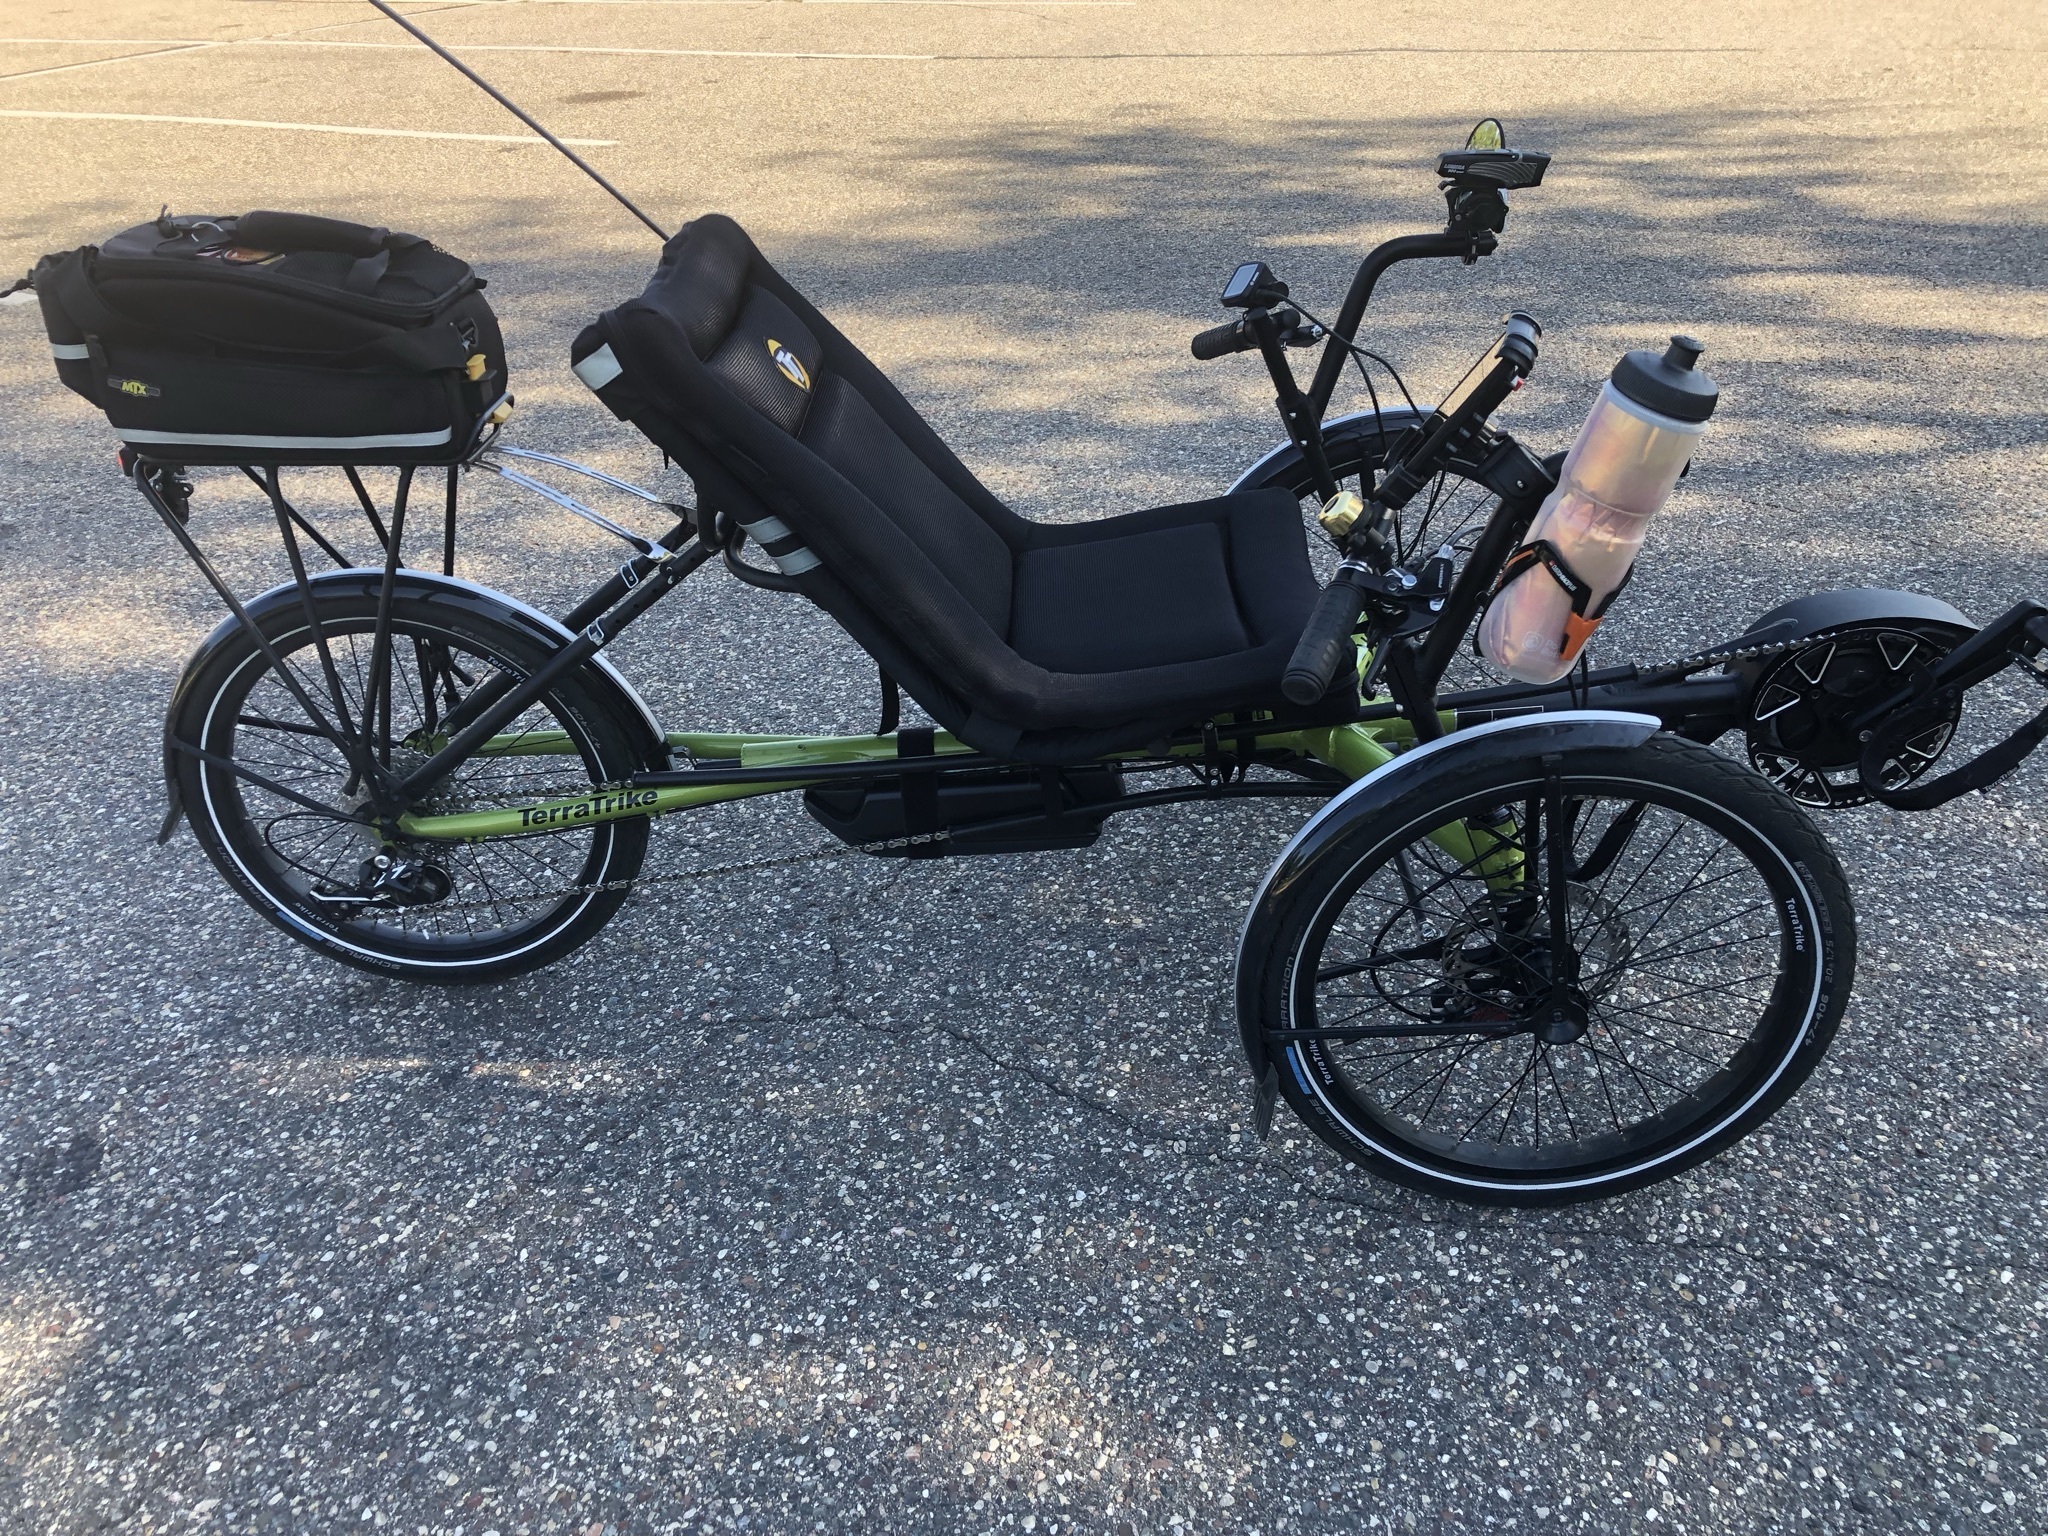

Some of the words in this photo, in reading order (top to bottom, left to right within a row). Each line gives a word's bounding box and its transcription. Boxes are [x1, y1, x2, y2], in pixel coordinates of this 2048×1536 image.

[486, 655, 527, 684] TerraTri
[518, 790, 658, 827] TerraTrike
[295, 902, 340, 933] TerraTrike
[1785, 898, 1806, 952] TerraTrike
[1308, 1039, 1335, 1086] TerraTrike
[1308, 1098, 1375, 1157] SCHWALBE
